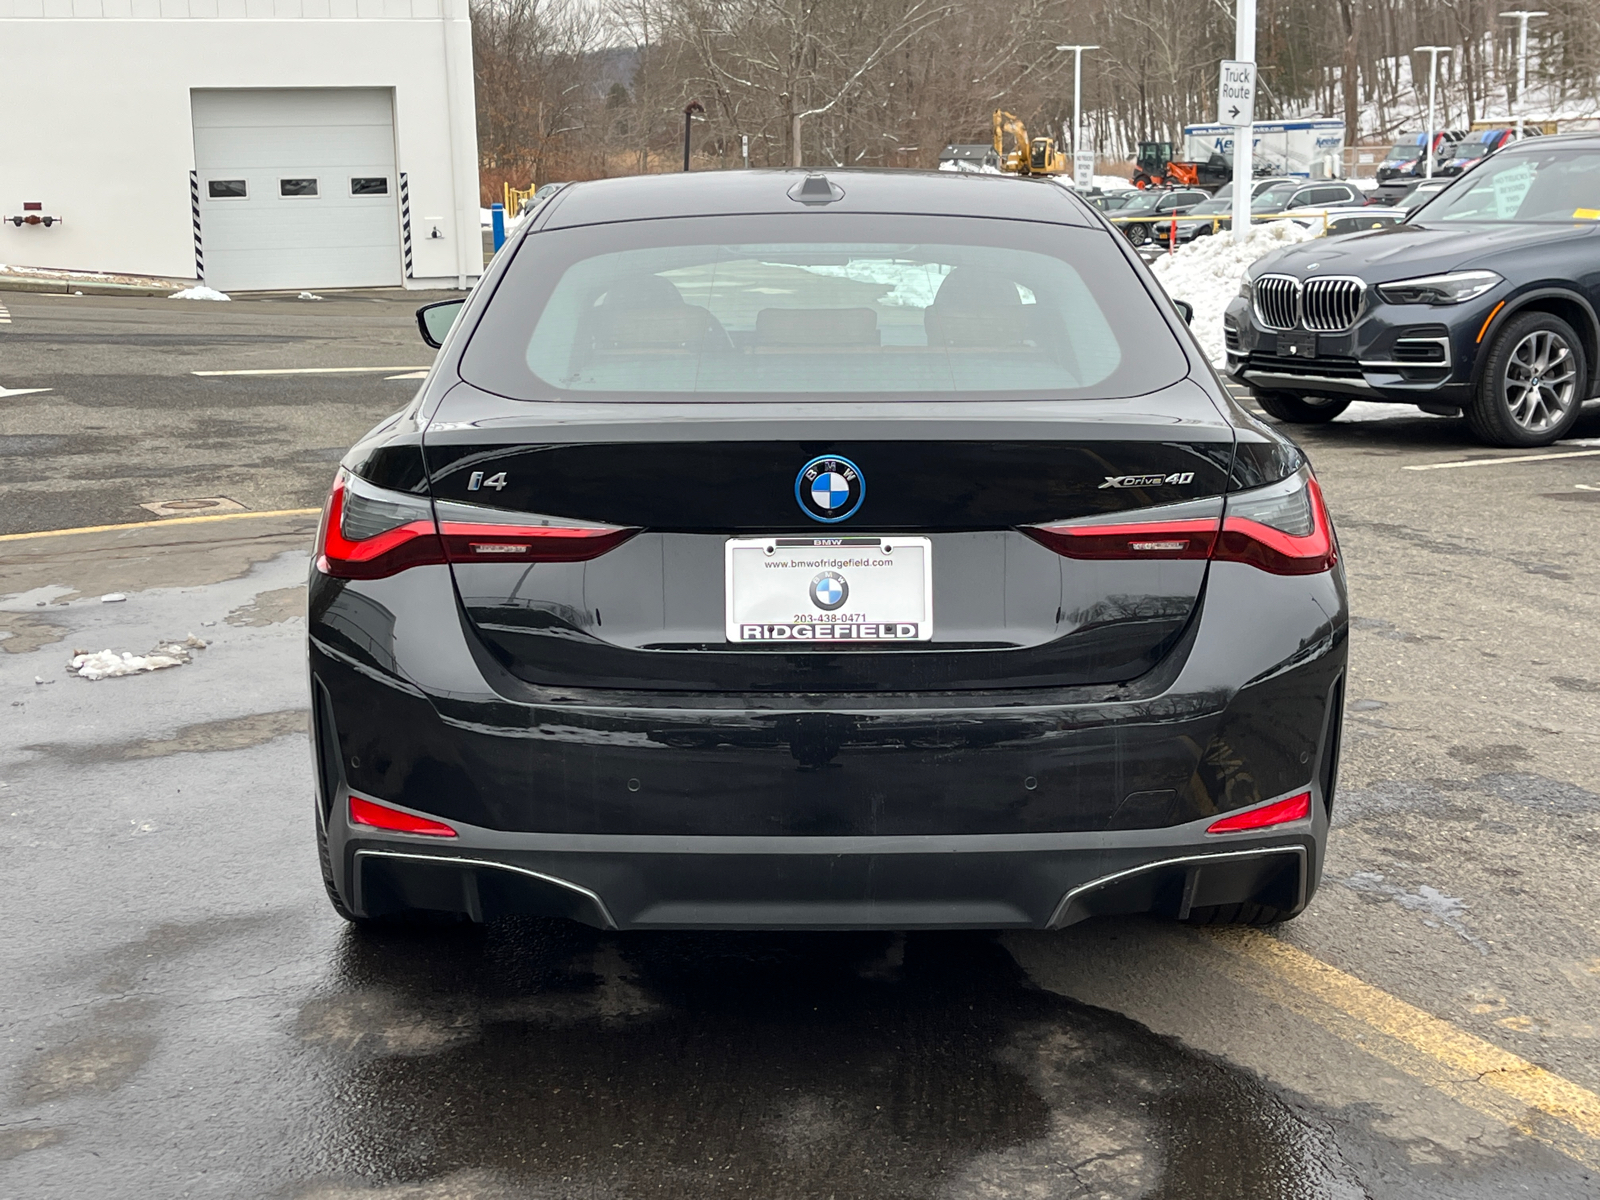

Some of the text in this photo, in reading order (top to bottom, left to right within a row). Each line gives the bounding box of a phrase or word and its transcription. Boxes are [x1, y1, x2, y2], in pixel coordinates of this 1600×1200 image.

[1225, 67, 1250, 83] Truck
[1222, 84, 1250, 99] Route
[467, 471, 508, 491] i4
[764, 558, 893, 569] www.bmwofridgefield.com
[793, 614, 867, 623] 203-438-0471
[743, 624, 916, 639] RIDGEFIELD
